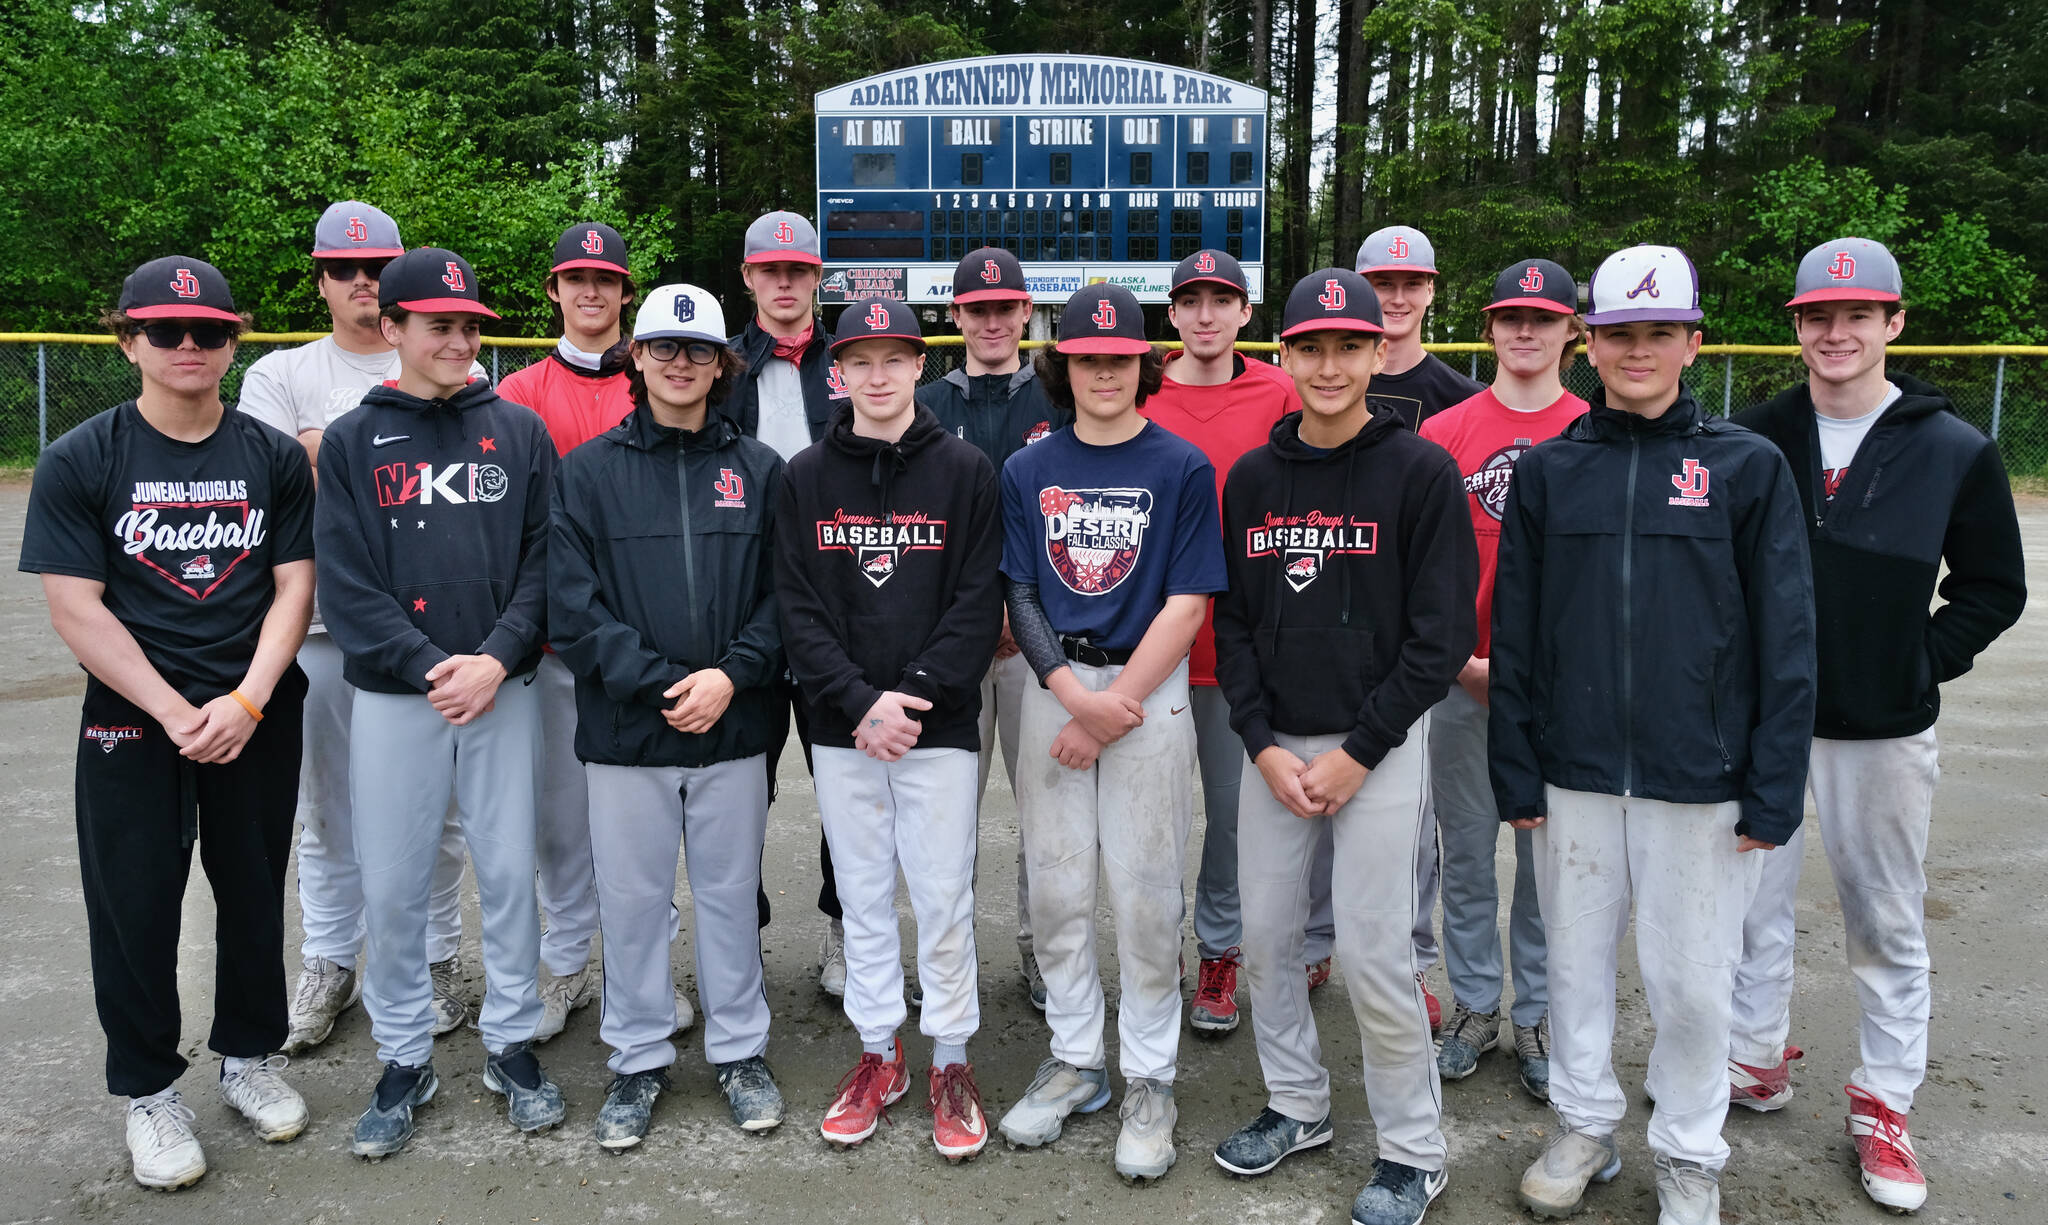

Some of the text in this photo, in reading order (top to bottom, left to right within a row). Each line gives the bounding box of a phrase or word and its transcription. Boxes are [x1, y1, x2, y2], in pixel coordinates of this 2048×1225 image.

[850, 62, 1232, 106] ADAIR KENNEDY MEMORIAL PARK
[846, 119, 902, 146] AT BAT
[951, 119, 992, 146] BALL
[1029, 118, 1093, 145] STRIKE
[1123, 118, 1160, 145] OUT
[1193, 118, 1204, 144] H
[1238, 118, 1246, 144] E
[935, 193, 1110, 208] 1 2 3 4 5 6 7 8 9 10
[1128, 193, 1158, 207] RUNS
[1174, 193, 1199, 207] HITS
[1214, 192, 1257, 207] ERRORS
[345, 217, 368, 242] JD
[581, 230, 604, 254] JD
[774, 221, 794, 244] JD
[1387, 236, 1410, 261] JD
[847, 268, 902, 279] CRIMSON
[981, 260, 1001, 284] JD
[1194, 252, 1216, 273] JD
[1827, 251, 1856, 280] JD
[170, 268, 200, 298] JD
[442, 261, 466, 291] JD
[854, 279, 894, 290] BEARS
[1025, 283, 1079, 292] BASEBALL
[1108, 276, 1146, 284] ALASKA
[1143, 284, 1170, 292] LINES
[1519, 267, 1544, 292] JD
[1319, 279, 1346, 311] JD
[865, 303, 890, 330] JD
[1092, 299, 1117, 329] JD
[714, 468, 744, 501] JD
[1672, 458, 1709, 498] JD
[132, 479, 248, 503] JUNEAU-DOUGLAS
[114, 508, 267, 555] Baseball
[823, 525, 942, 545] BASEBALL
[1048, 511, 1147, 546] DESERT
[1253, 528, 1370, 552] BASEBALL
[1067, 534, 1131, 550] FALL CLASSIC
